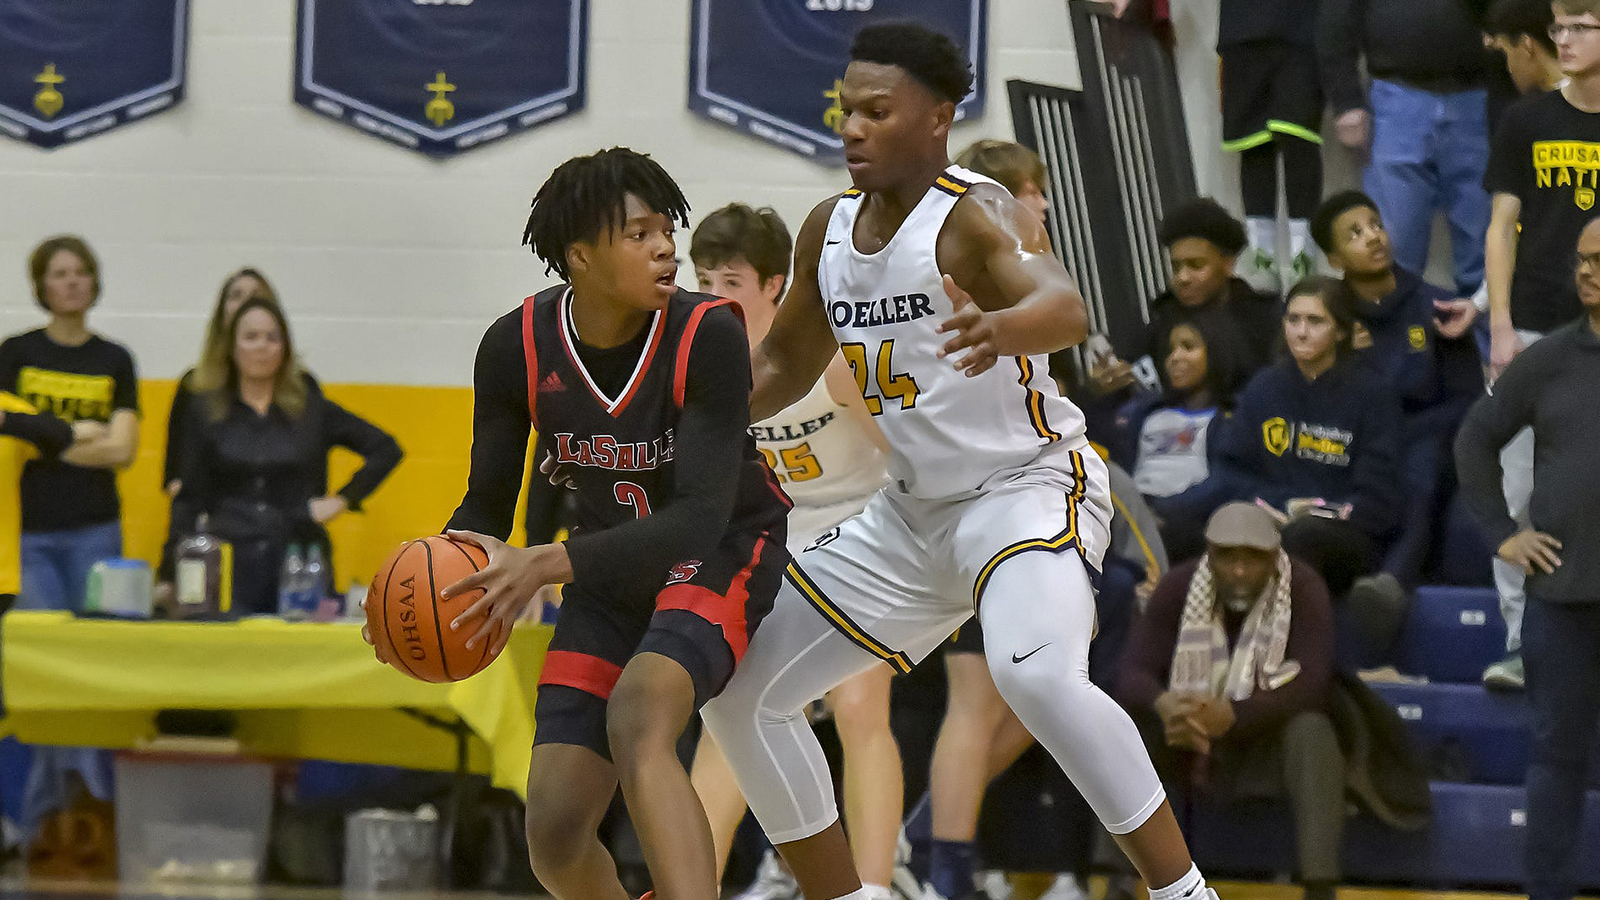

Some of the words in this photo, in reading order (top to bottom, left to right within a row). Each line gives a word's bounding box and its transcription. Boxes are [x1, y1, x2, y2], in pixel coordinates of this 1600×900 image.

[1536, 167, 1598, 188] NATI
[1538, 147, 1599, 163] CRUSA
[841, 338, 921, 417] 24
[399, 573, 426, 661] OHSAA
